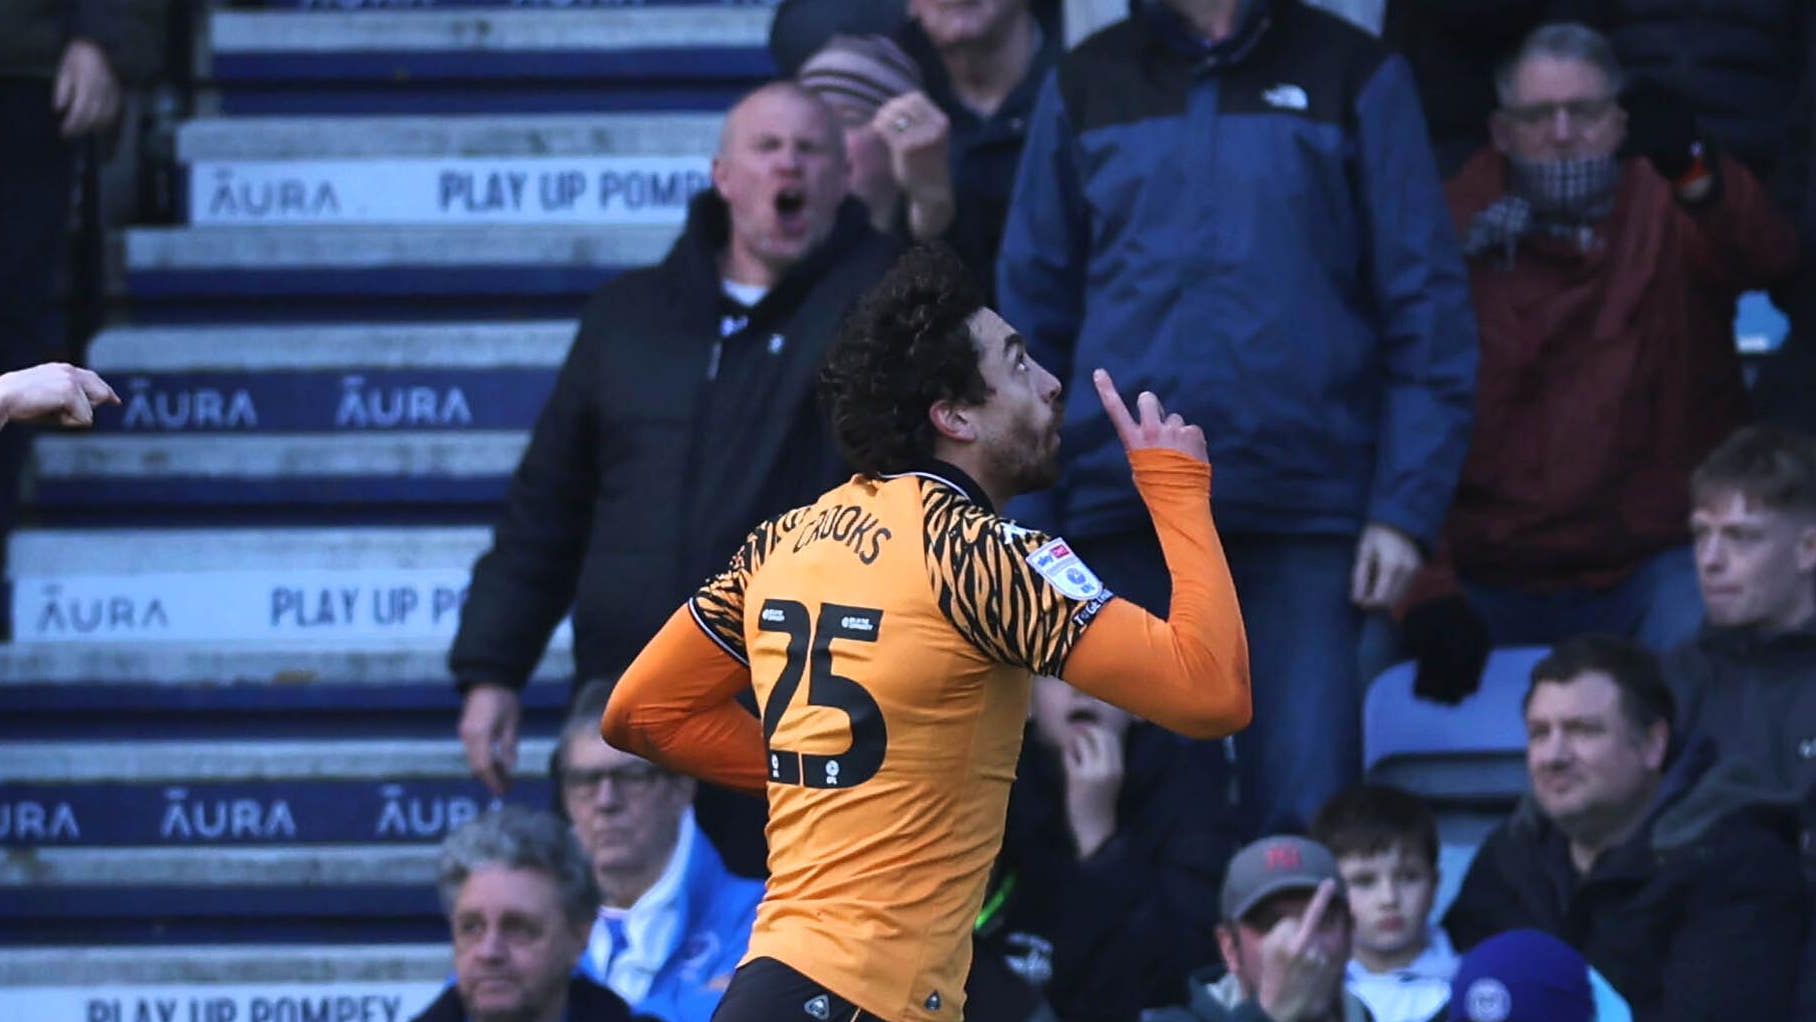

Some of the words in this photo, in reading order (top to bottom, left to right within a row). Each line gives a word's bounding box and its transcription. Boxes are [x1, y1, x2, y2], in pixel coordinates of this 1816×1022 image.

[439, 171, 528, 211] PLAY
[539, 172, 587, 209] UP
[599, 171, 710, 209] POMP
[271, 587, 360, 627] PLAY
[372, 588, 418, 625] UP
[754, 598, 888, 788] 25
[376, 785, 478, 835] ĀUR
